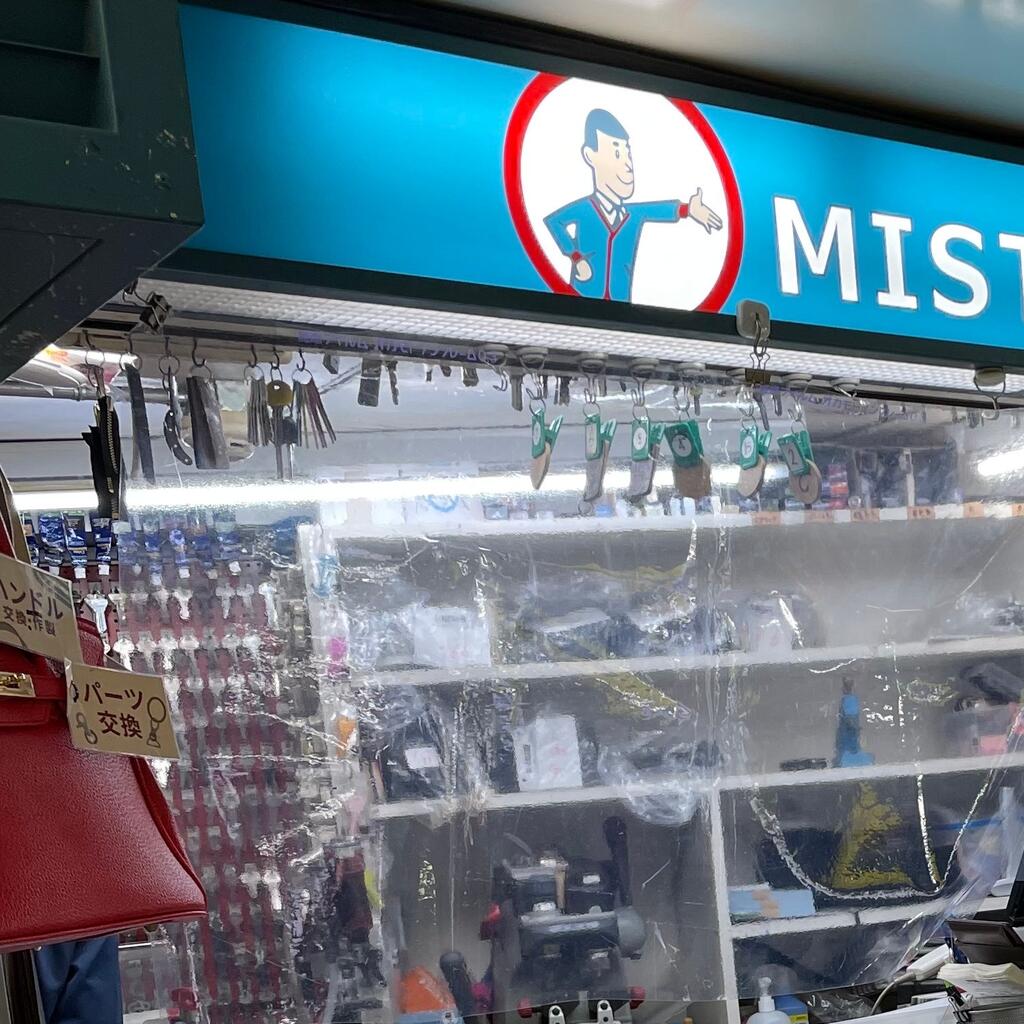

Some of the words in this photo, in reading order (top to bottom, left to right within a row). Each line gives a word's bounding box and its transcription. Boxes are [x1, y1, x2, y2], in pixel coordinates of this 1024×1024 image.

[83, 681, 143, 710] パーツ
[97, 710, 143, 739] 交換
